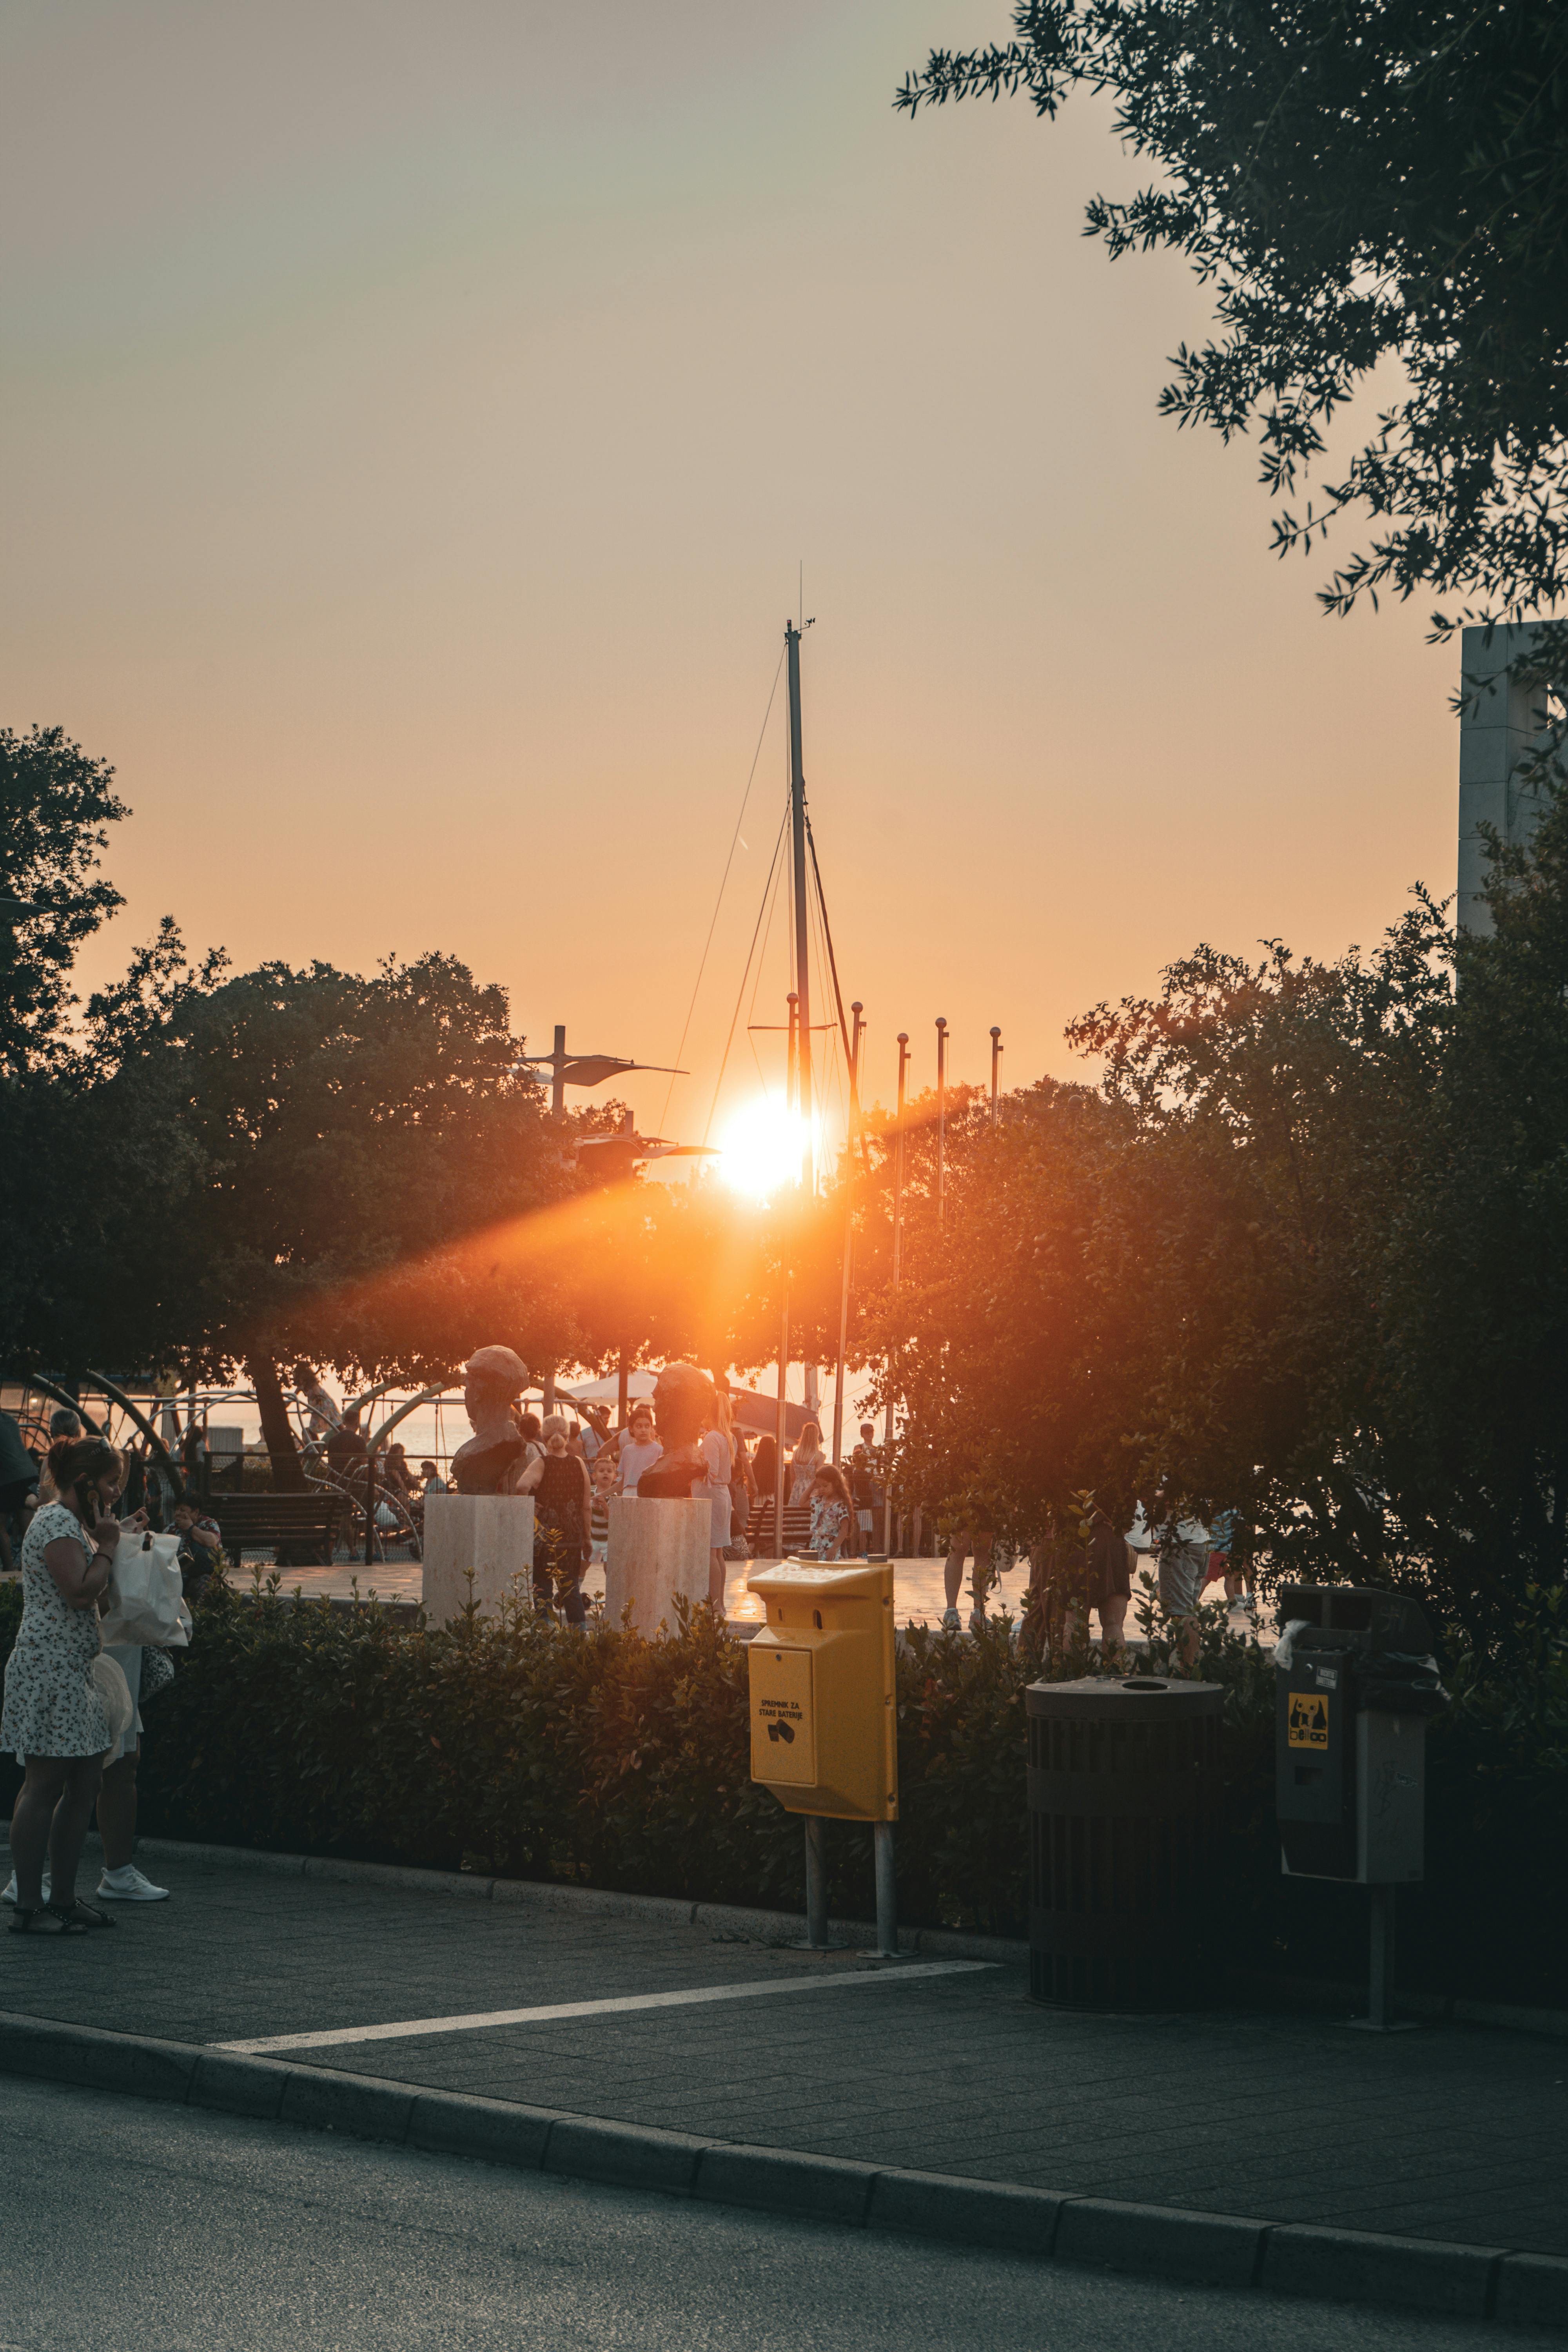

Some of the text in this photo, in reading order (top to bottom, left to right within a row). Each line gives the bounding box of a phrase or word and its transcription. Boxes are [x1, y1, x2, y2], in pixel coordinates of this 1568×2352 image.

[761, 1700, 788, 1708] SPREMNIK
[778, 1710, 803, 1720] BATERIJE
[1290, 1728, 1326, 1742] belloo
